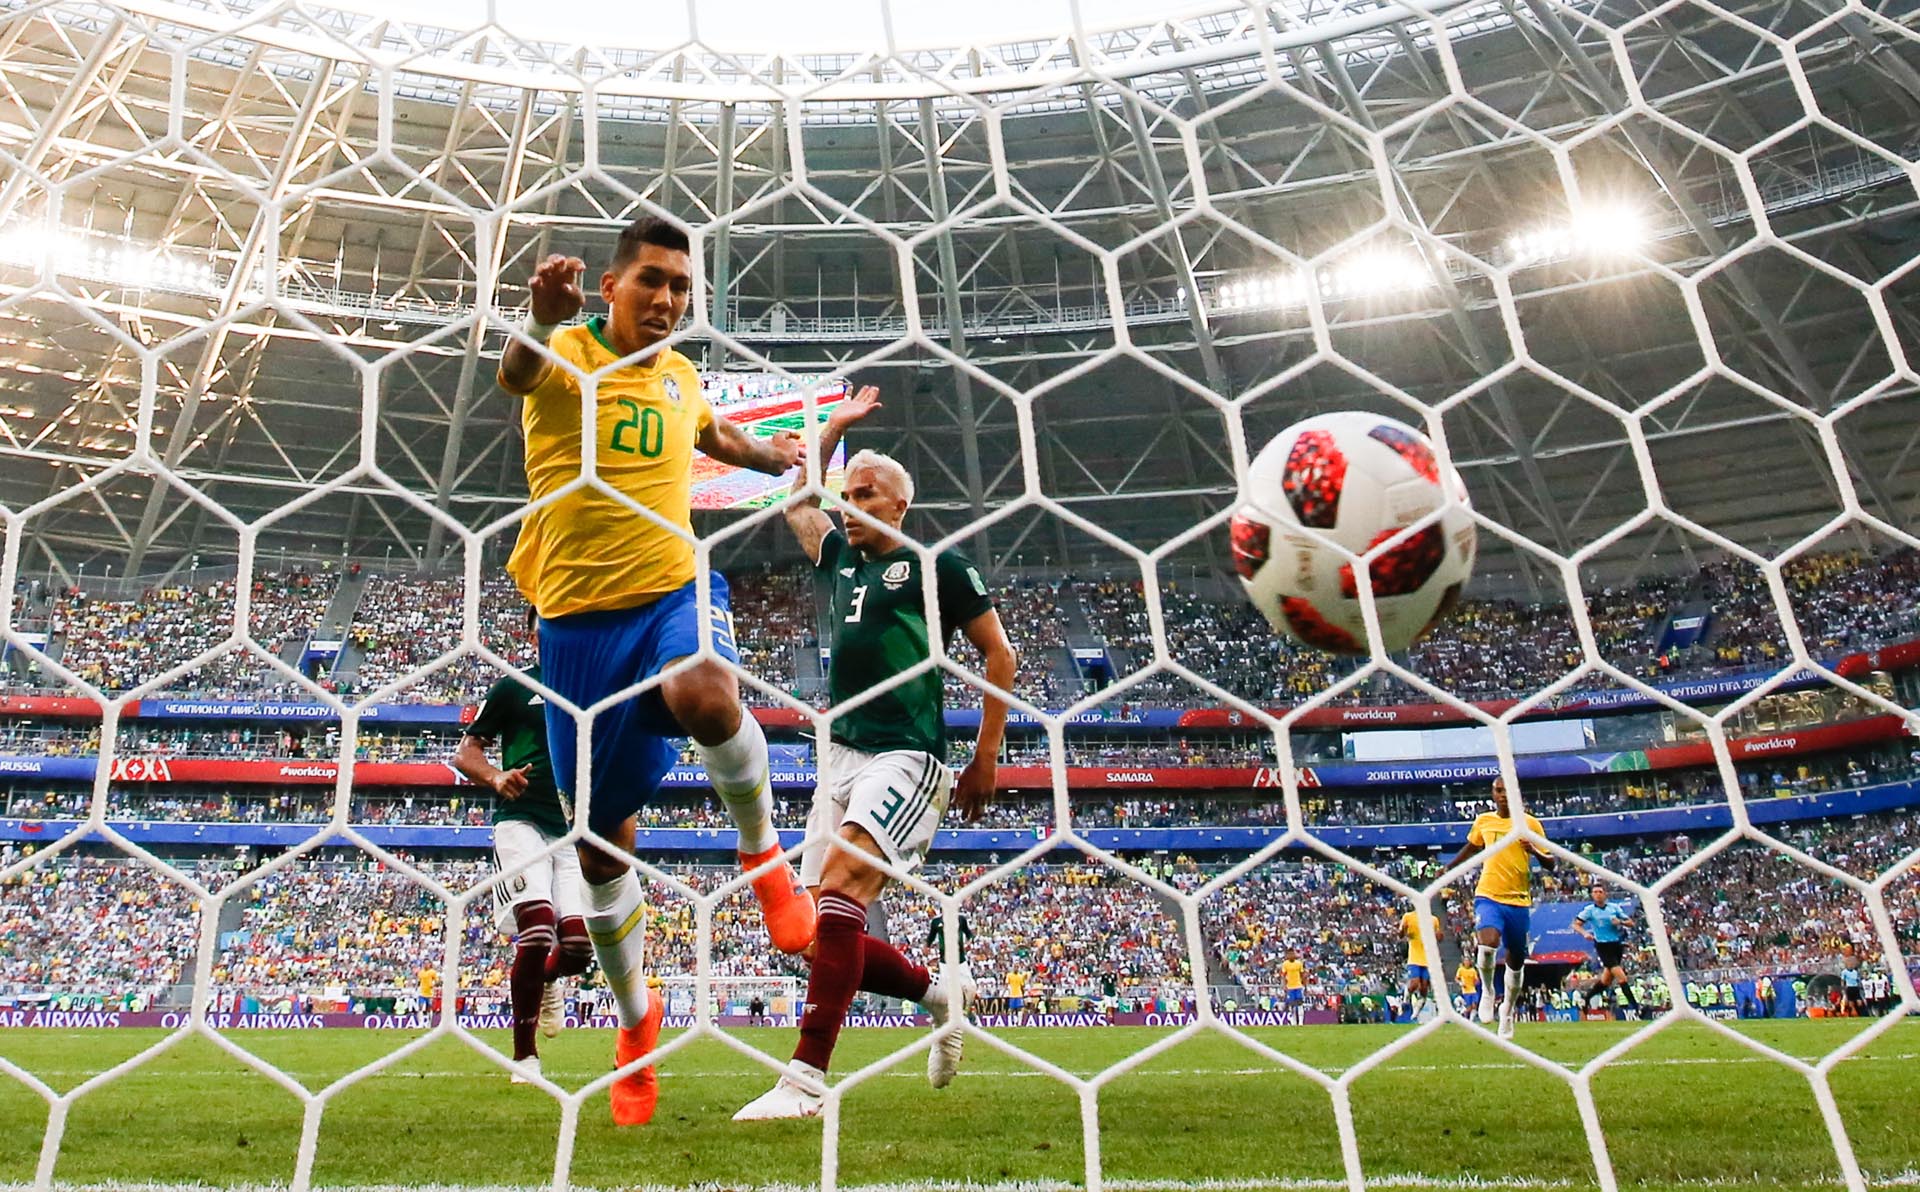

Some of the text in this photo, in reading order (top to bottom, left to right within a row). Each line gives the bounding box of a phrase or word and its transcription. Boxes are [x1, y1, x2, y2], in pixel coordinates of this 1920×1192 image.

[610, 398, 664, 458] 20
[844, 585, 868, 623] 3
[1719, 681, 1741, 692] FIFA
[165, 703, 229, 715] ЧЕМПИОНАТ
[263, 705, 279, 716] ПО
[280, 705, 330, 717] ФУТБОЛУ
[360, 707, 379, 717] 018
[1343, 710, 1397, 721] #worldcup
[1081, 713, 1103, 723] CUP
[1743, 736, 1797, 753] #worldcup
[0, 761, 41, 773] RUSSIA
[279, 765, 337, 779] #worldcup
[1366, 766, 1501, 782] 2018 FIFA WORLD CUP RUS
[678, 772, 694, 782] ПО
[771, 773, 795, 783] 2018
[1105, 772, 1154, 783] SAMARA
[870, 785, 906, 830] 3
[29, 1012, 120, 1028] AIRWAYS
[161, 1013, 324, 1029] QAAR AIRWAYS
[845, 1015, 915, 1028] IRWAYS
[1025, 1014, 1108, 1028] AIRWAYS
[1145, 1013, 1198, 1027] QATA
